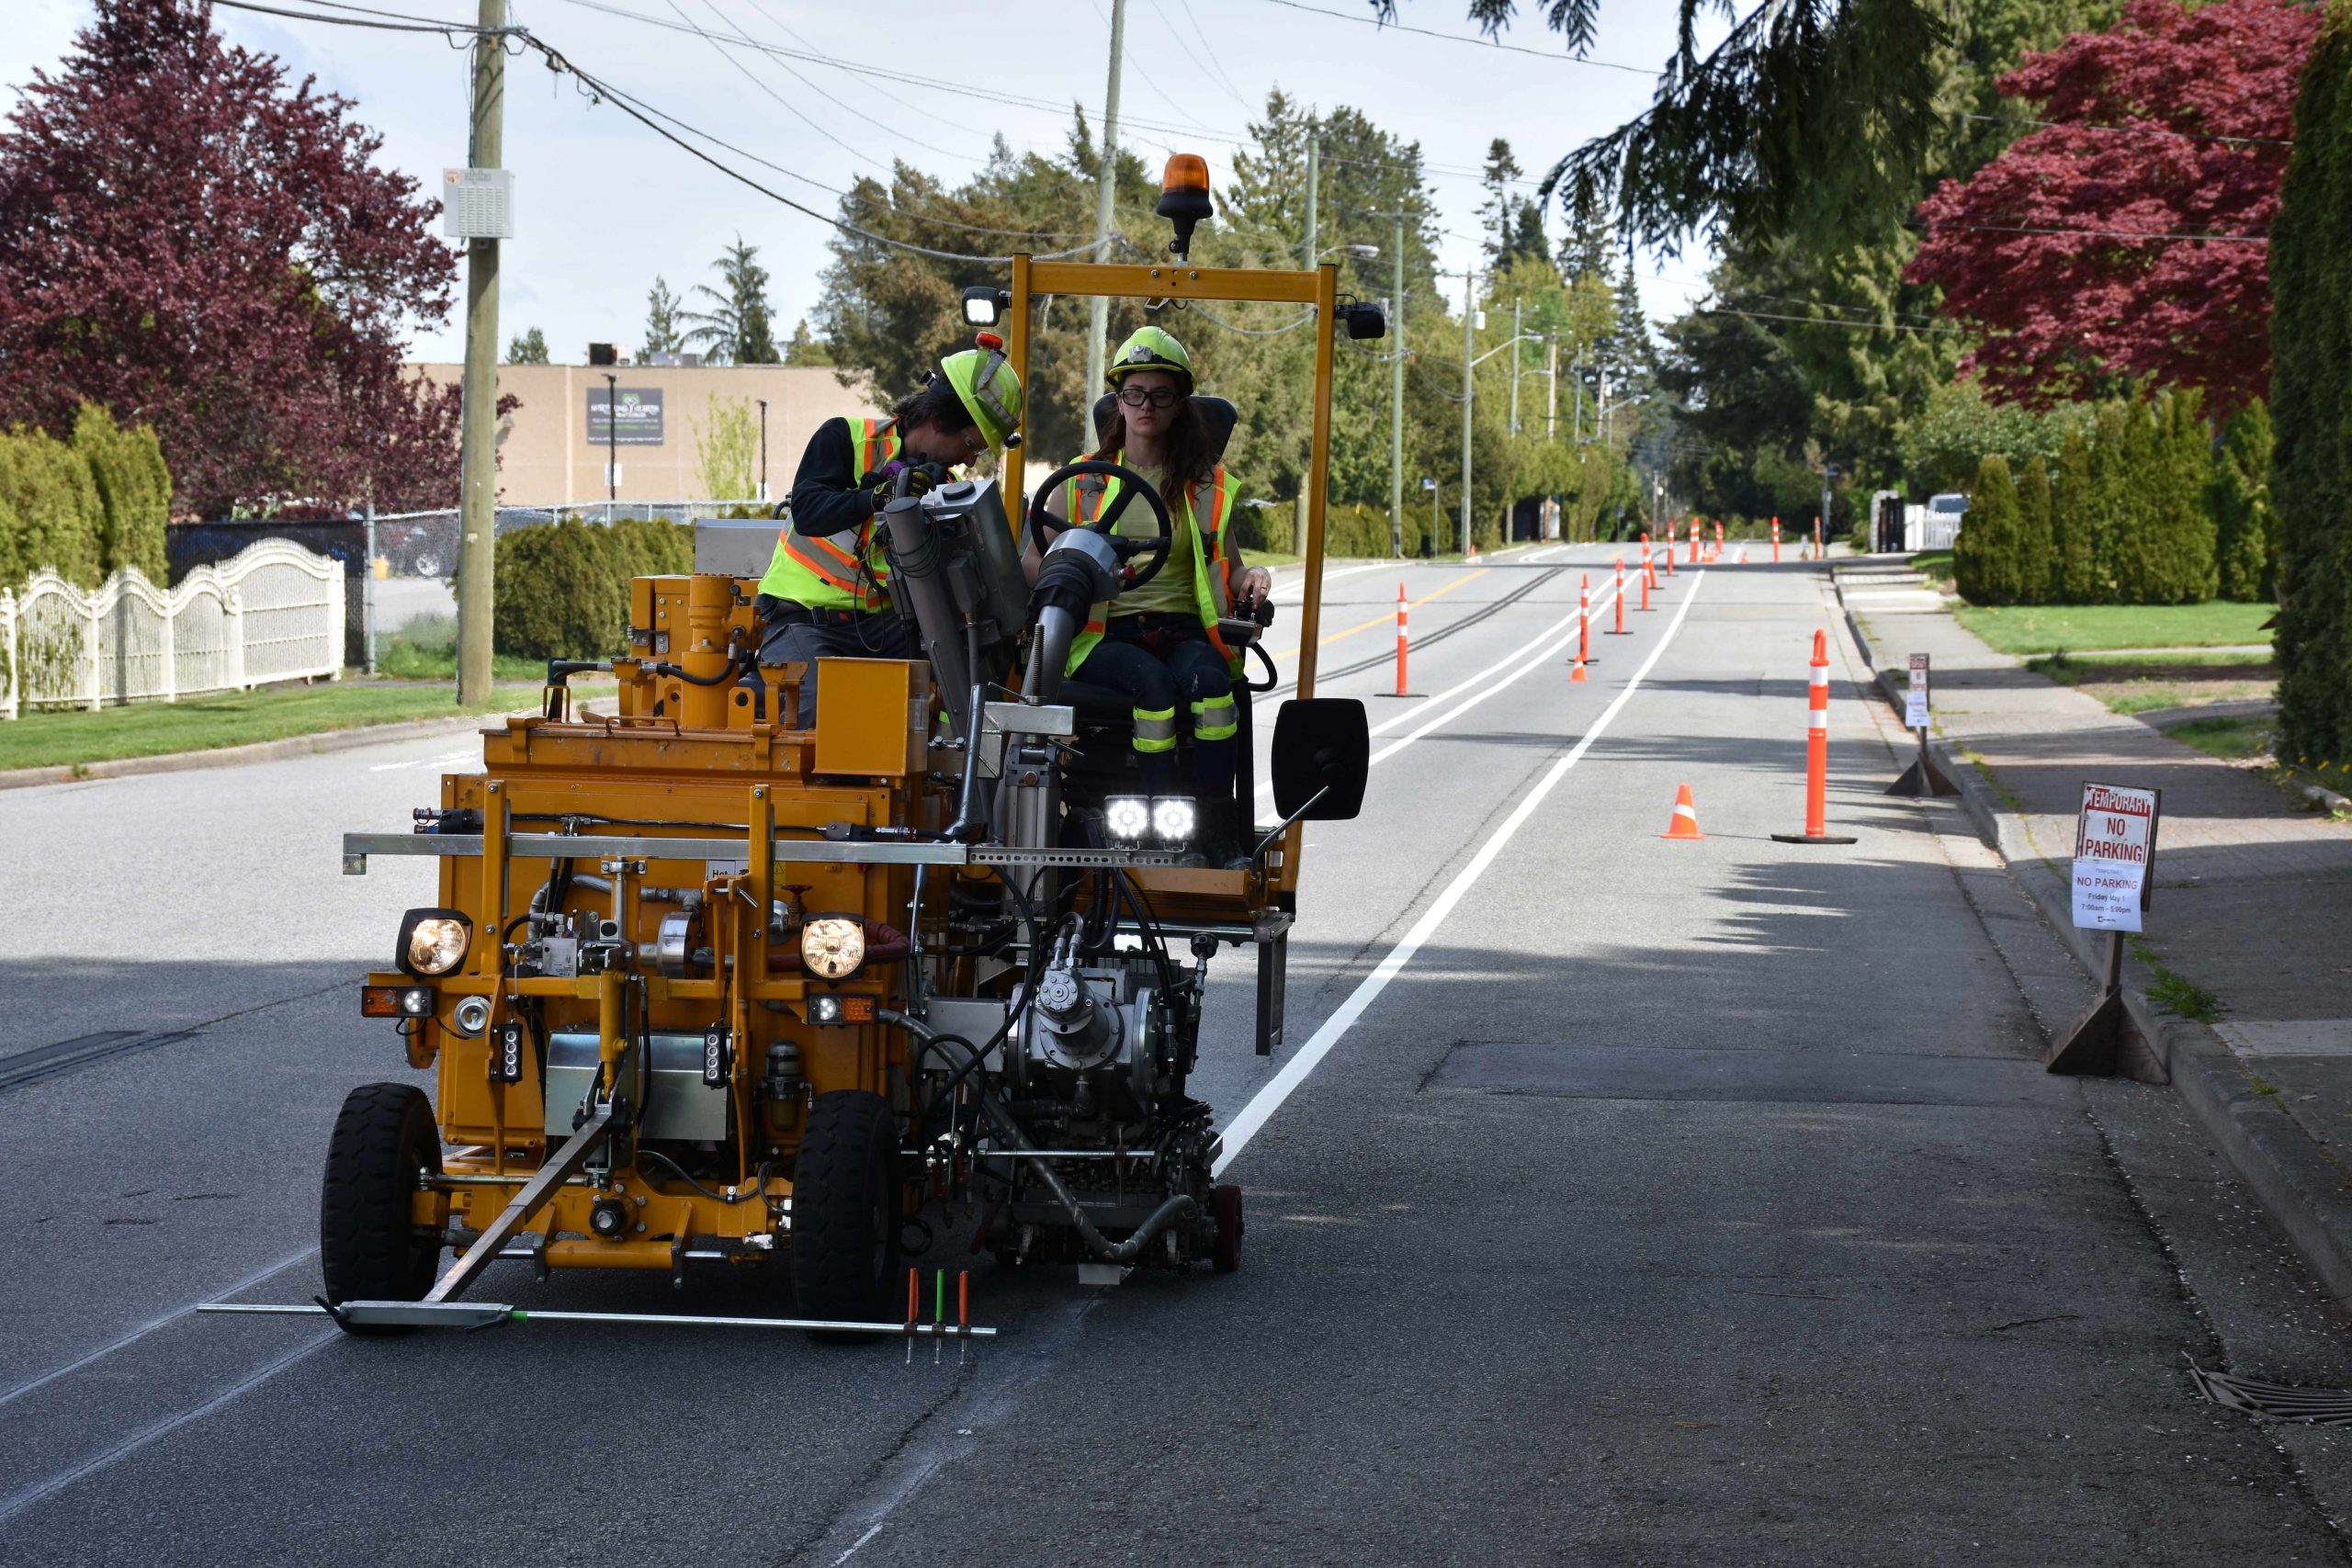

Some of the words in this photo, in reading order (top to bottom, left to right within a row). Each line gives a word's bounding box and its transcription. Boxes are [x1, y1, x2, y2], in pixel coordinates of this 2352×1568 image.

[2088, 789, 2148, 813] TEMPORARY
[2107, 817, 2125, 836] NO
[2085, 839, 2143, 862] PARKING
[2076, 876, 2092, 886] NO
[2095, 877, 2138, 890] PARKING
[2087, 893, 2108, 902] Friday
